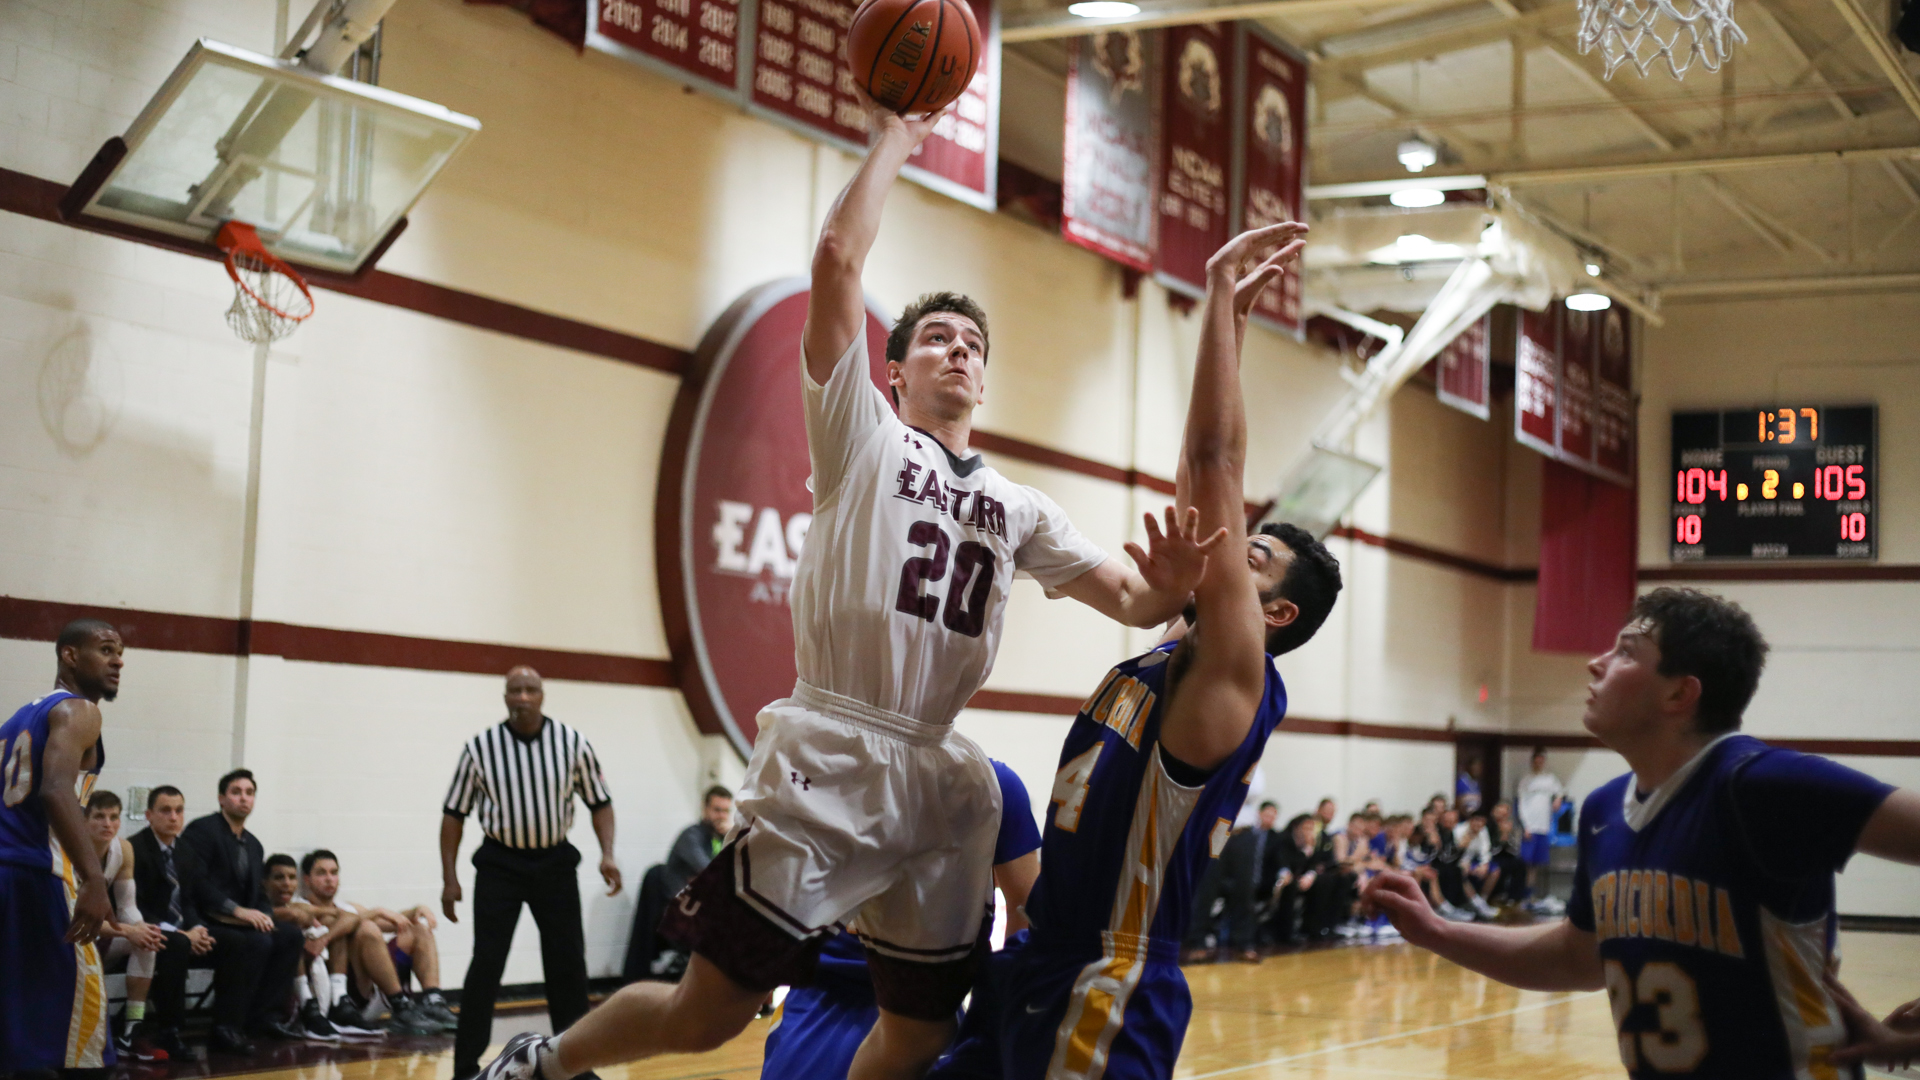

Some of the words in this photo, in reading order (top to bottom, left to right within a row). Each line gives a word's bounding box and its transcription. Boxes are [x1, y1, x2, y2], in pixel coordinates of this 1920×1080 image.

[652, 14, 689, 52] 2014
[1758, 407, 1818, 444] 1:37
[1677, 467, 1728, 504] 104
[1815, 465, 1866, 501] 105
[1676, 514, 1702, 545] 10
[1840, 512, 1866, 542] 10
[895, 520, 996, 638] 20
